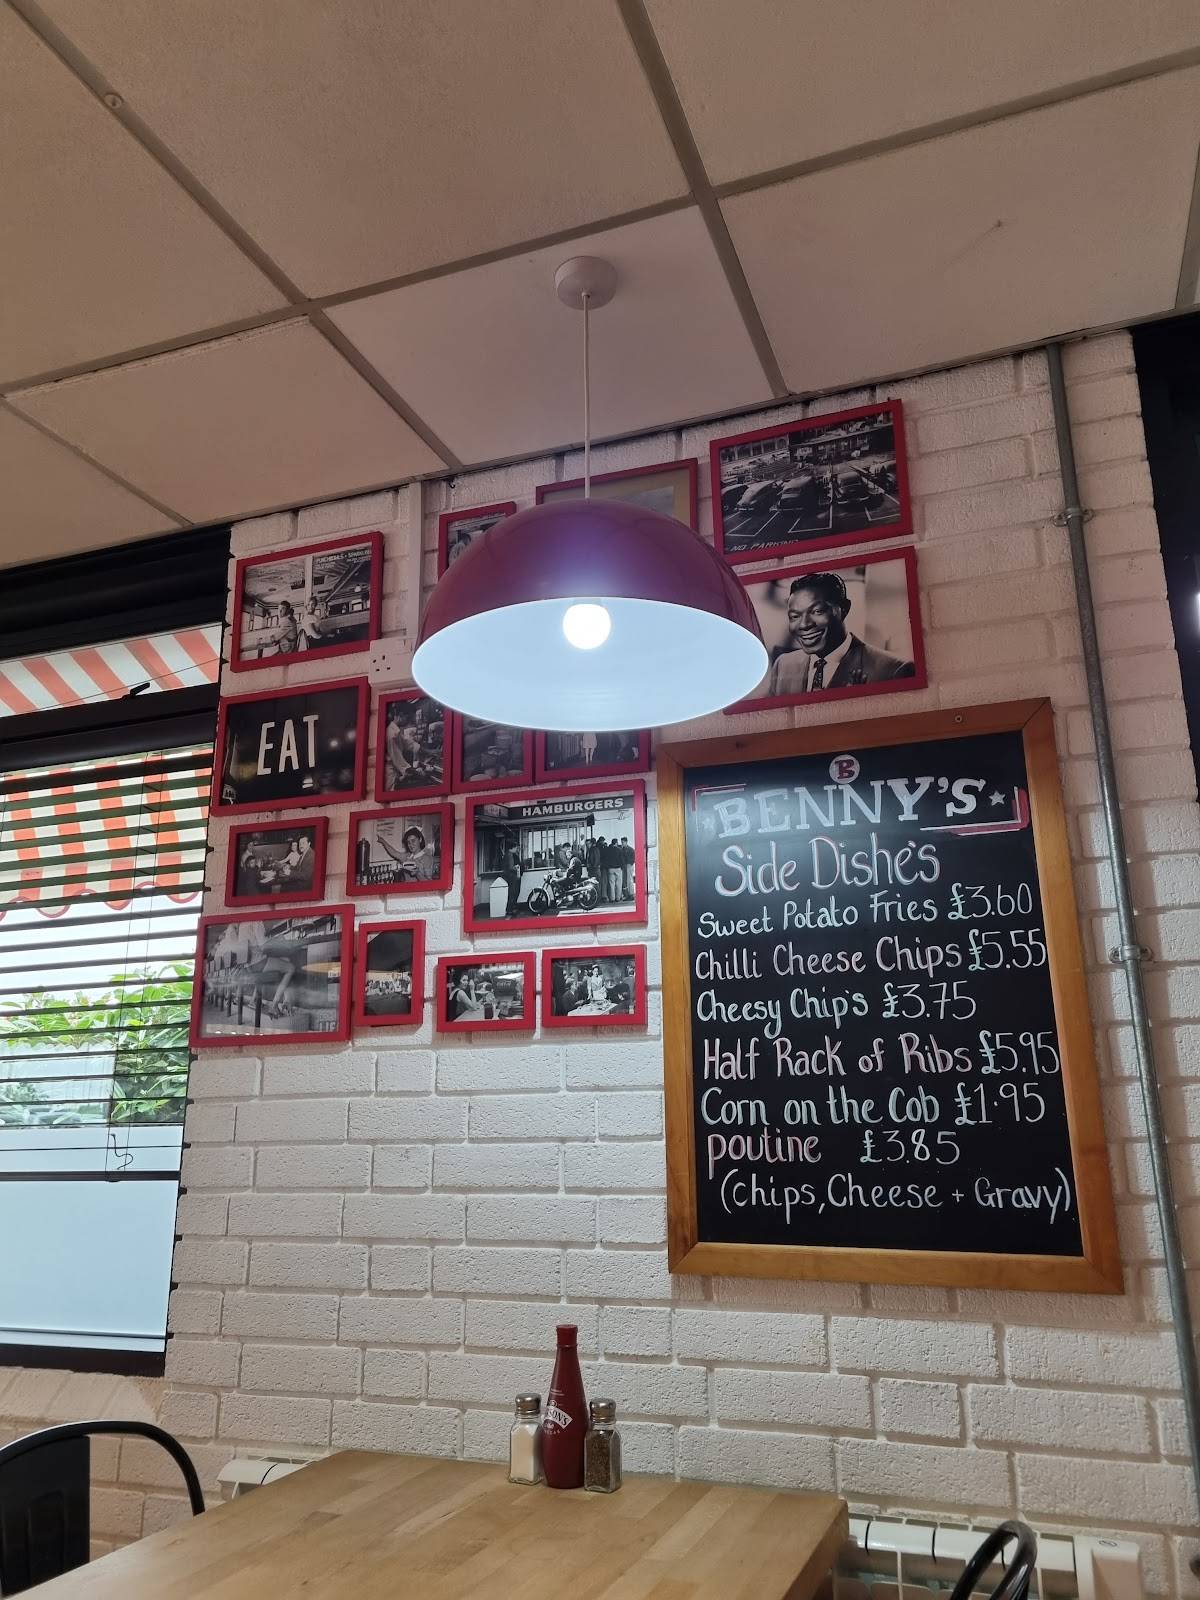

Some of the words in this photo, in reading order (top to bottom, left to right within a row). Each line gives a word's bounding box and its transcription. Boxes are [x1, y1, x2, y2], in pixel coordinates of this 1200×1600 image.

[257, 714, 319, 776] EAT
[834, 759, 855, 780] B
[522, 797, 624, 817] HAMBURGERS
[713, 776, 987, 839] BENNY'S
[714, 841, 800, 897] Side
[697, 906, 773, 938] Sweet
[783, 896, 858, 930] Potato
[870, 890, 938, 922] Fries
[948, 883, 1033, 920] £3.60
[695, 952, 762, 980] Chilli
[773, 942, 866, 975] Cheese
[876, 936, 963, 978] Chips
[968, 928, 1046, 972] £5.55
[697, 989, 782, 1039] Cheesy
[882, 980, 977, 1020] £3.75
[703, 1038, 760, 1080] Half
[773, 1036, 847, 1078] Rack
[858, 1038, 884, 1073] of
[898, 1033, 972, 1074] Ribs
[979, 1030, 1060, 1075] £5.95
[701, 1087, 770, 1125] Corn
[784, 1098, 821, 1124] on
[826, 1086, 882, 1123] the
[888, 1086, 939, 1123] Cob
[707, 1128, 822, 1180] poutine
[860, 1128, 960, 1165] £3.85
[975, 1168, 1071, 1224] Gravy)
